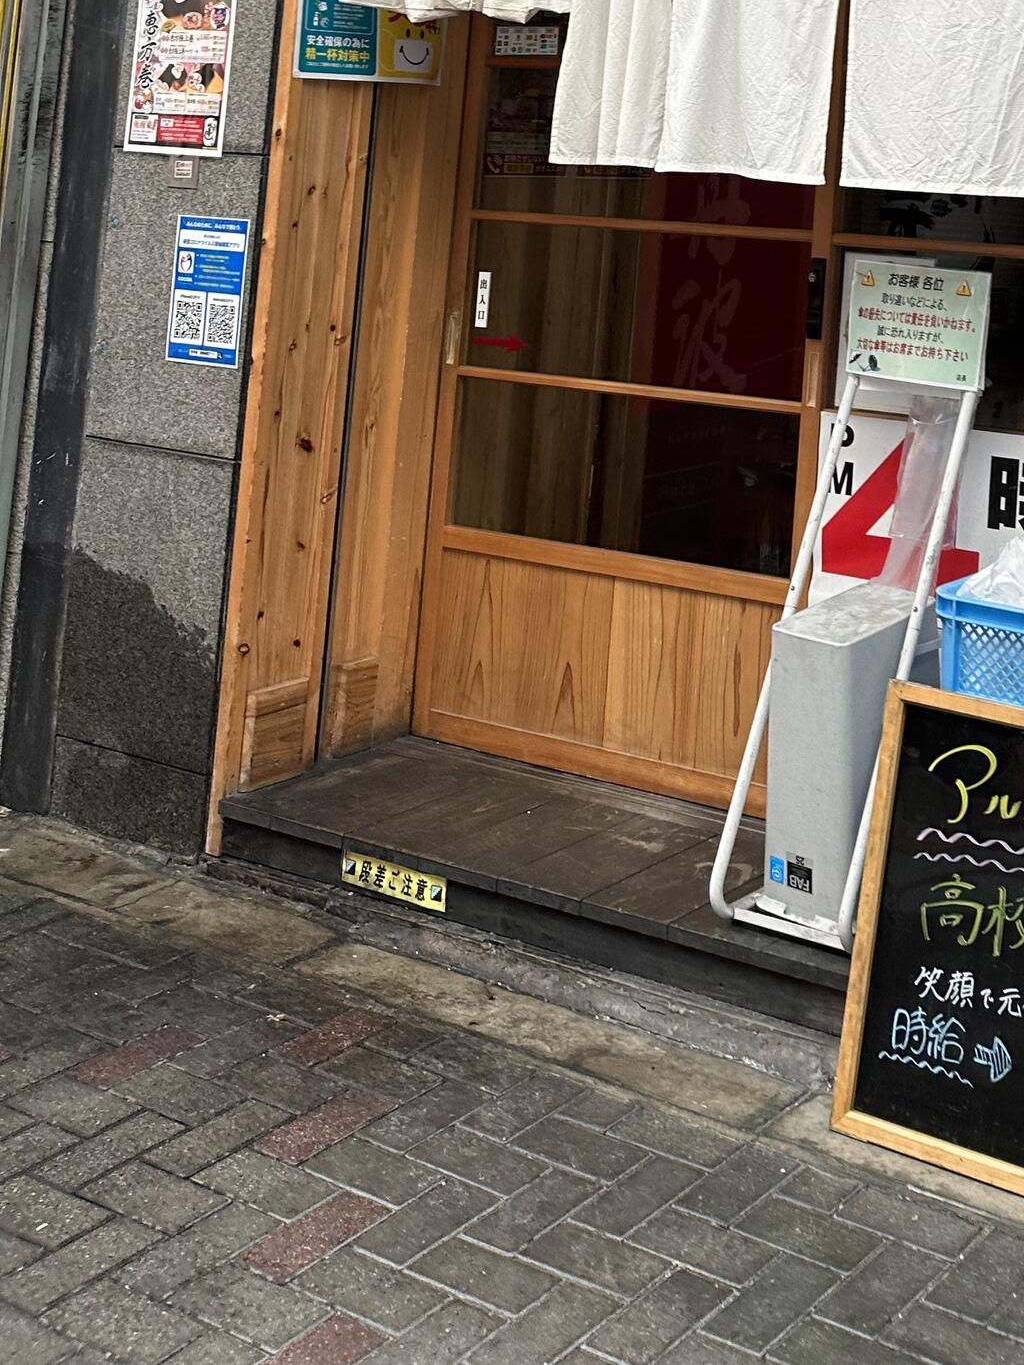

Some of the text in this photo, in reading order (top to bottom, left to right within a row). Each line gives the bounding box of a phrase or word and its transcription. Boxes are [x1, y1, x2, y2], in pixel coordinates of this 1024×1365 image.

[477, 278, 488, 321] 出入口
[888, 273, 944, 291] お客様 各位
[359, 860, 428, 902] 段差ご注意
[891, 1006, 966, 1065] 時給
